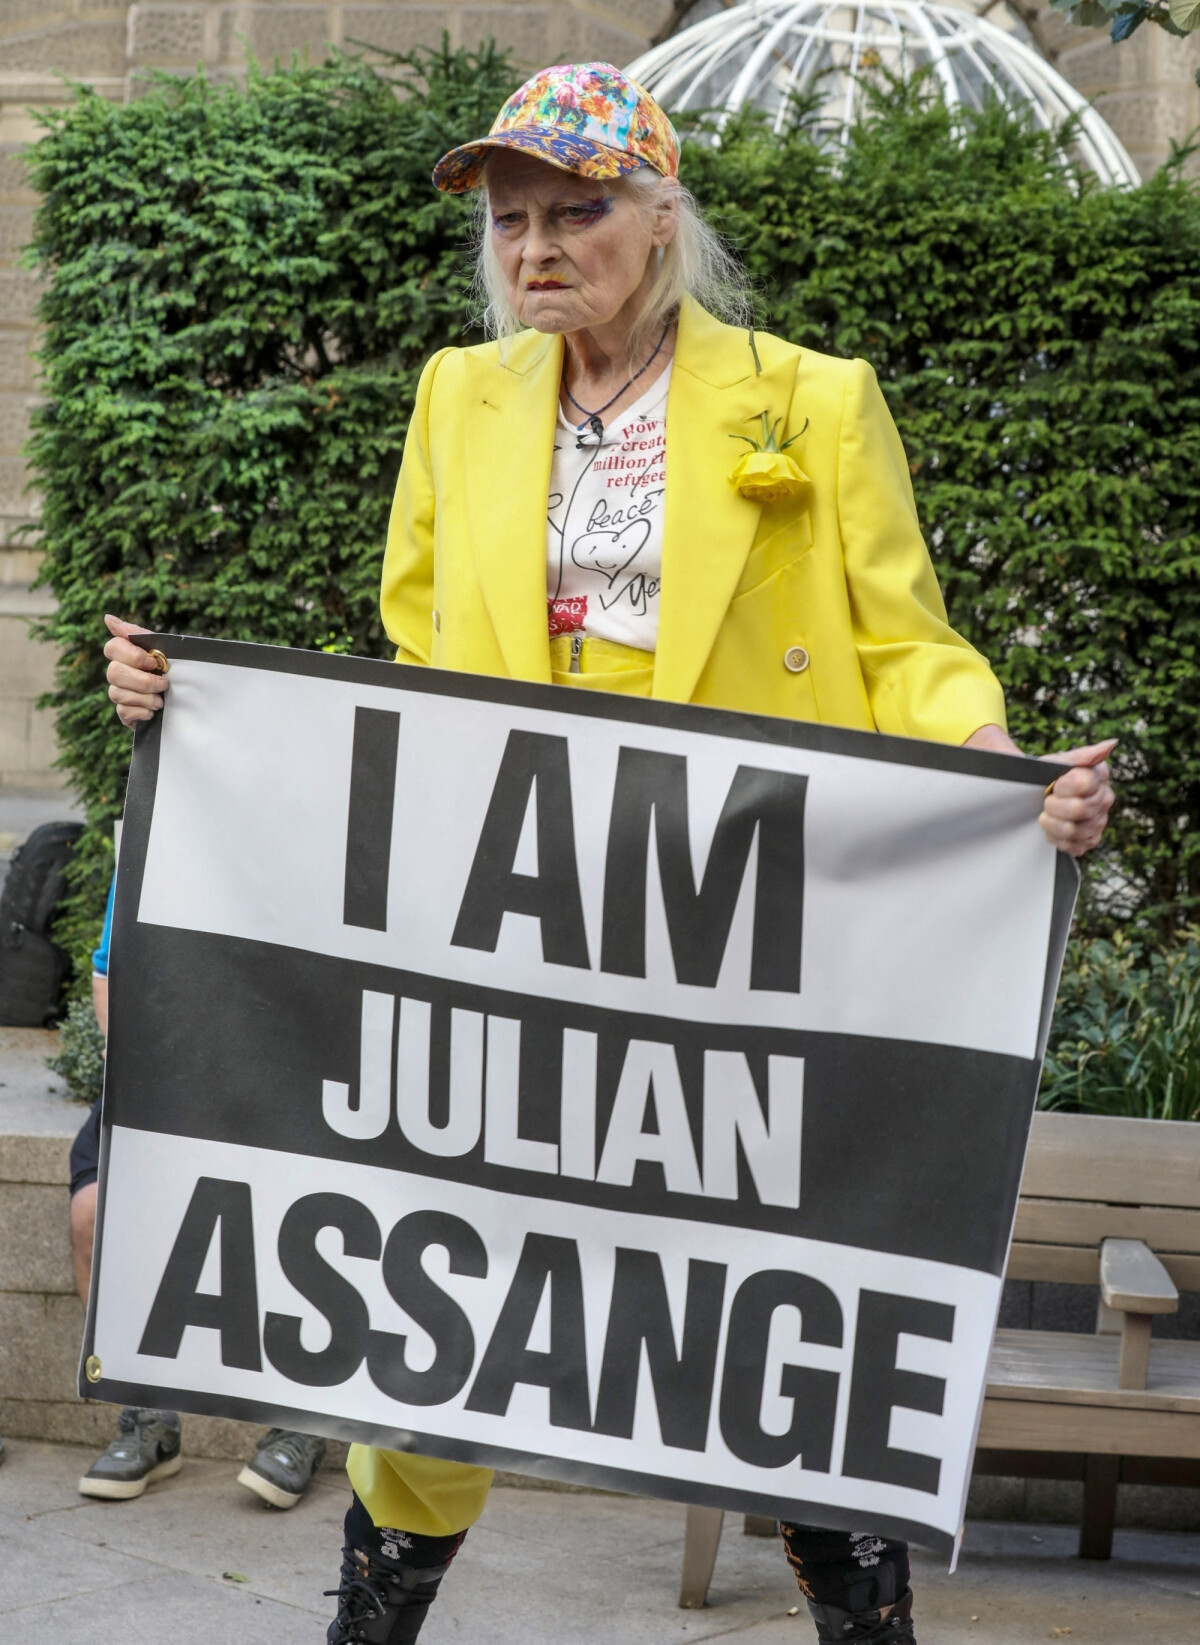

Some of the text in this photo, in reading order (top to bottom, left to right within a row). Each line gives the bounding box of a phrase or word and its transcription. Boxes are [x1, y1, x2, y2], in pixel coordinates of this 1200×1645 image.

[593, 456, 647, 472] million
[621, 420, 658, 440] How
[586, 498, 658, 532] Peace
[344, 706, 809, 995] I AM
[322, 989, 805, 1209] JULIAN
[136, 1176, 956, 1496] ASSANGE
